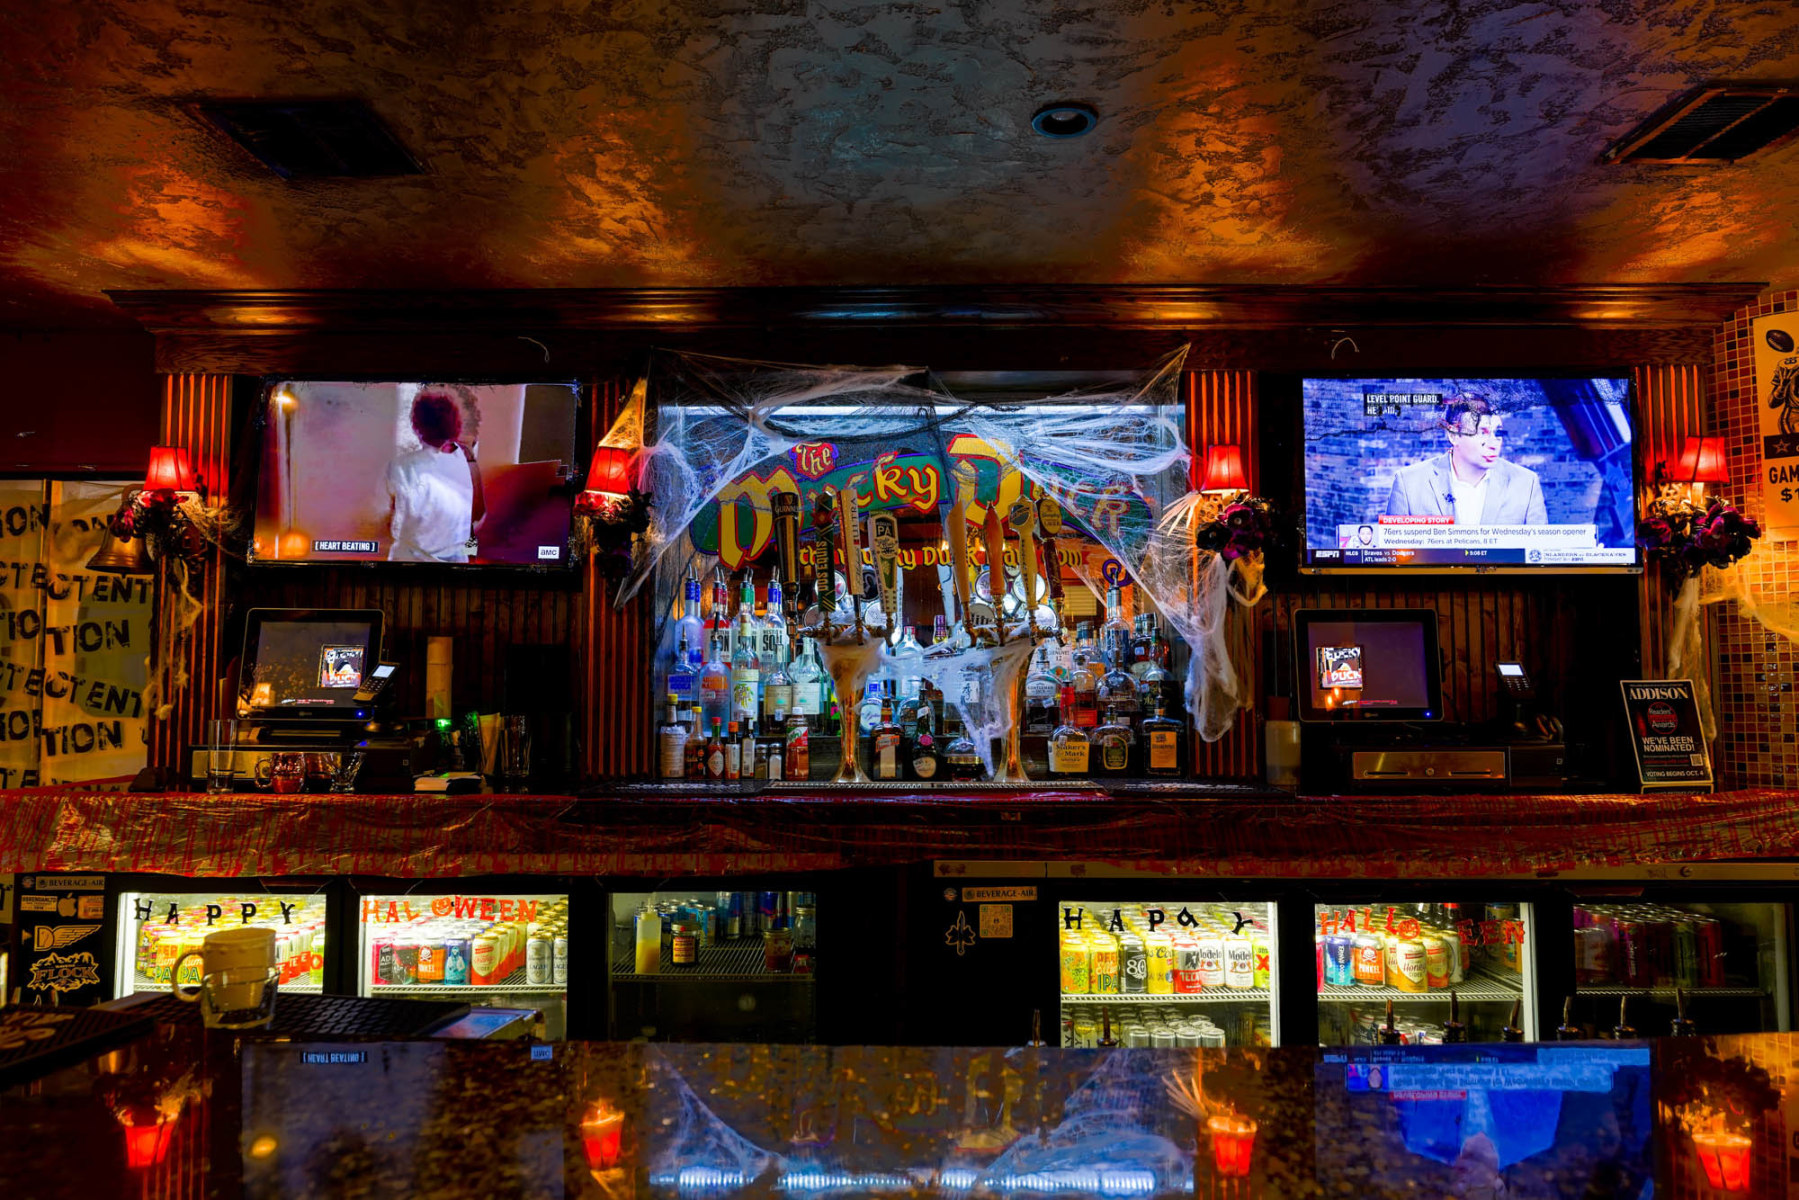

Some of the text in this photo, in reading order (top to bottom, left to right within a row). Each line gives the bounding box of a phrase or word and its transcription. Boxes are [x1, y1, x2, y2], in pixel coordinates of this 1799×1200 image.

[1366, 394, 1440, 403] LEVEL POINT GUARD.
[795, 442, 832, 476] The
[1403, 528, 1432, 537] suspend
[1491, 528, 1536, 537] Wednesday's
[319, 541, 340, 551] HEART
[342, 541, 370, 551] BEATING
[1315, 550, 1340, 558] ESPN
[816, 541, 829, 591] DOS EQUIS
[1629, 687, 1689, 700] ADDISON
[1642, 736, 1694, 745] WE'VE BEEN
[1643, 743, 1695, 753] NOMINATED!
[36, 966, 96, 981] FLOCK
